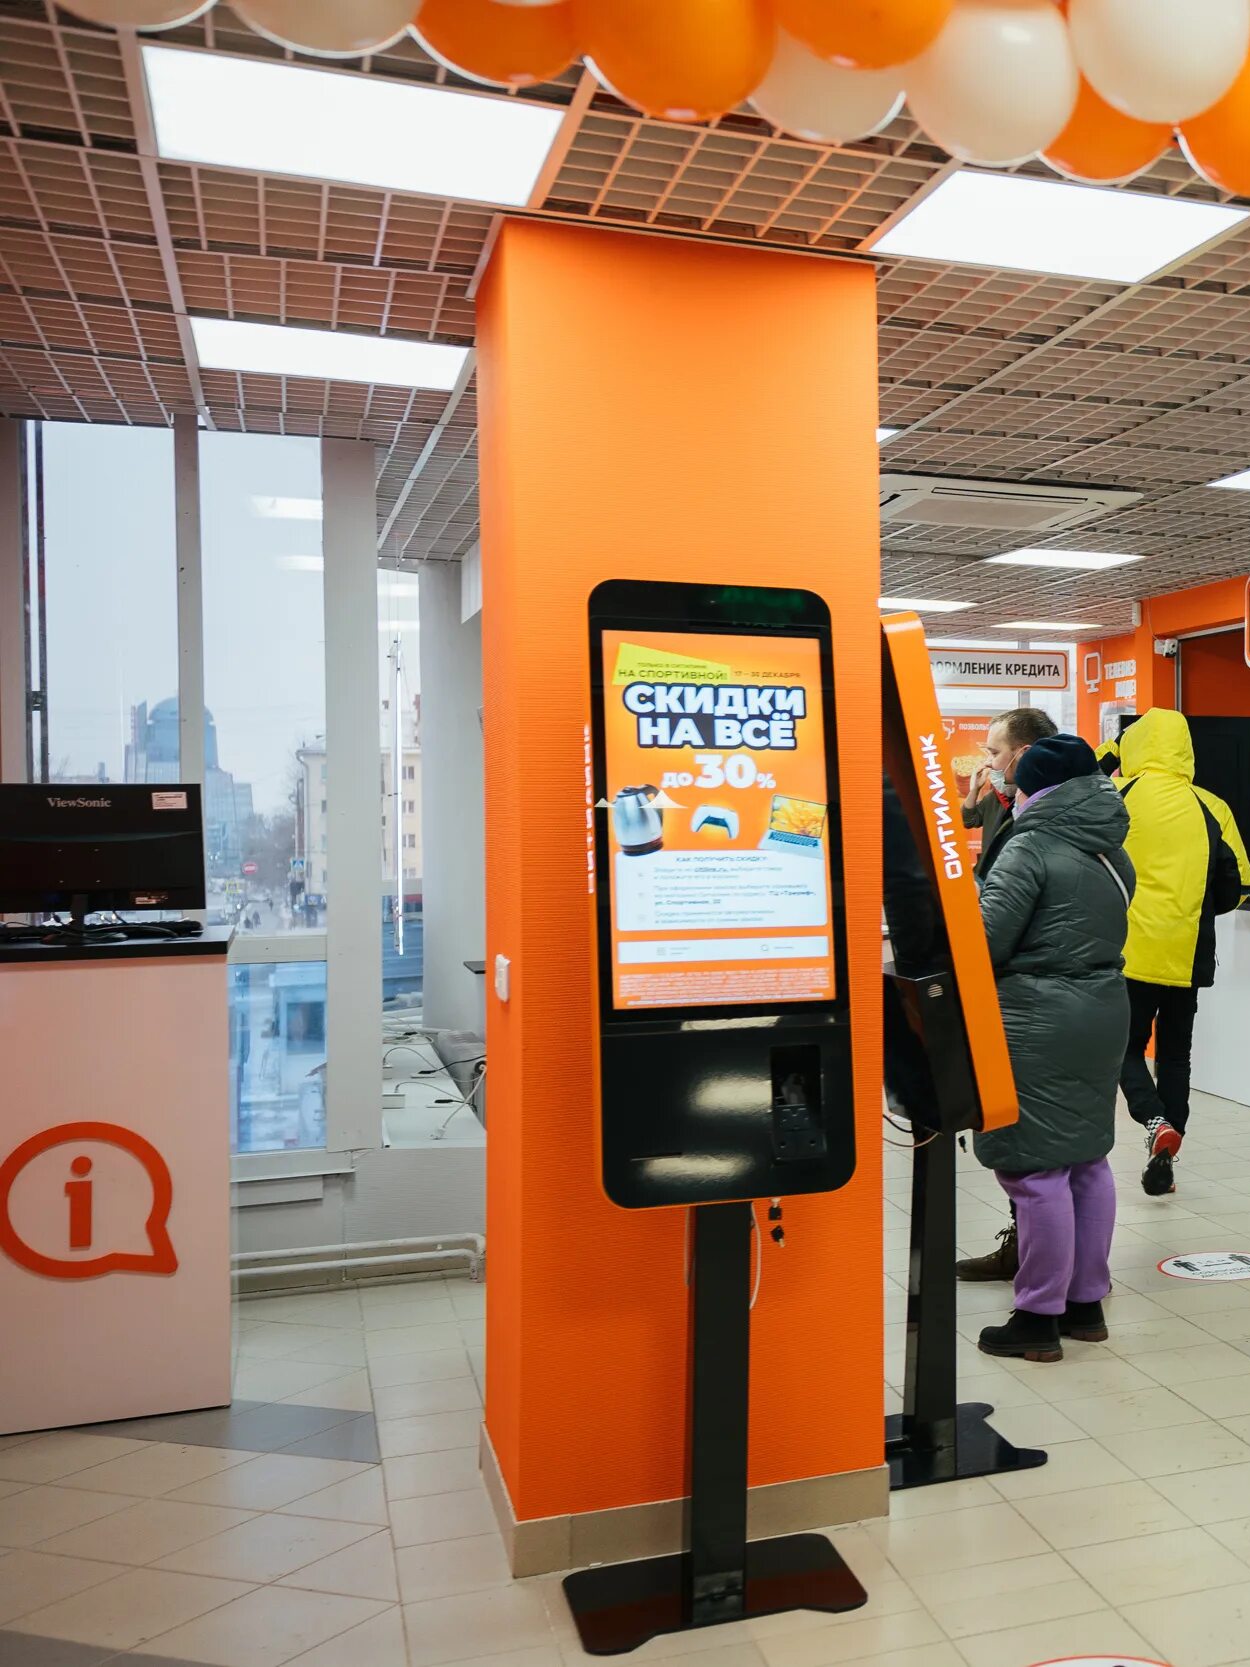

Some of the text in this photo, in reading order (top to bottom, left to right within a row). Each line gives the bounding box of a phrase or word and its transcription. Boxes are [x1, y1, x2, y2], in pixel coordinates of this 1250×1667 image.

[618, 669, 636, 678] НА
[931, 660, 1060, 678] ОРМЛЕНИЕ КРЕДИТА
[624, 683, 806, 720] СКИДКИ
[638, 712, 796, 748] НА ВСЁ
[47, 797, 112, 808] ViewSonic
